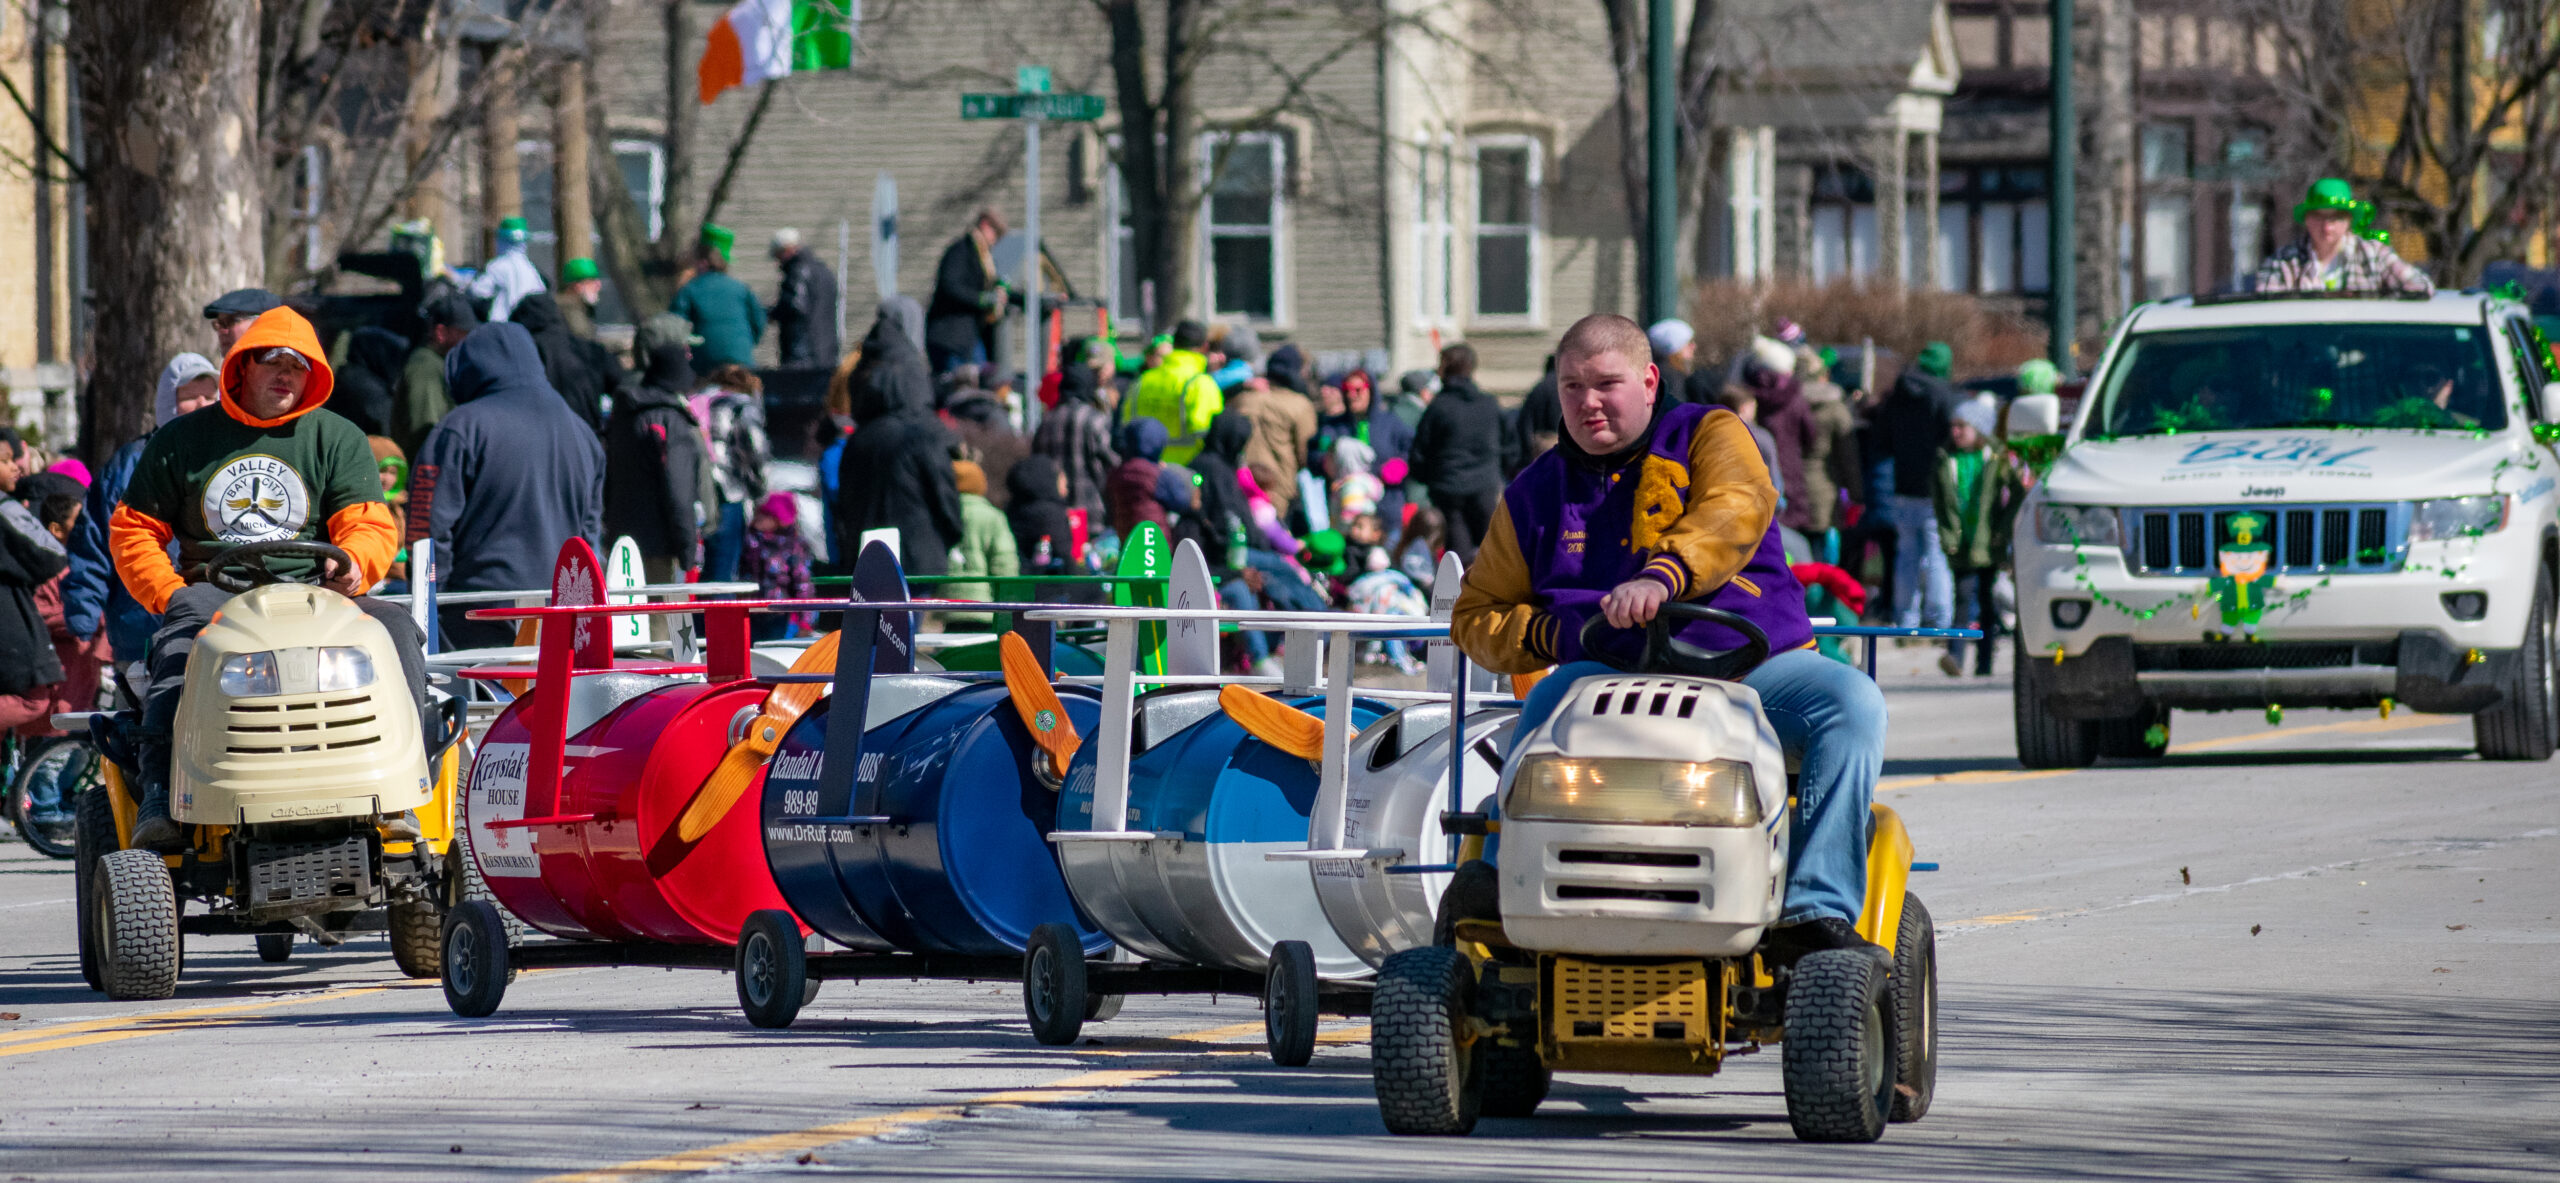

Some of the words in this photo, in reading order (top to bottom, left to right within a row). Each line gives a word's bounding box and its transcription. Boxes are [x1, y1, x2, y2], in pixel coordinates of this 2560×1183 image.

[2178, 439, 2378, 470] Bay
[227, 460, 287, 477] VALLEY
[227, 478, 248, 498] BAY
[261, 477, 285, 497] CITY
[2241, 484, 2286, 500] Jeep
[407, 465, 440, 561] CARHAR
[770, 749, 820, 780] Randall
[857, 752, 884, 783] DDS
[487, 789, 519, 806] HOUSE
[784, 790, 819, 815] 989-89
[481, 852, 535, 869] RESTAURANT
